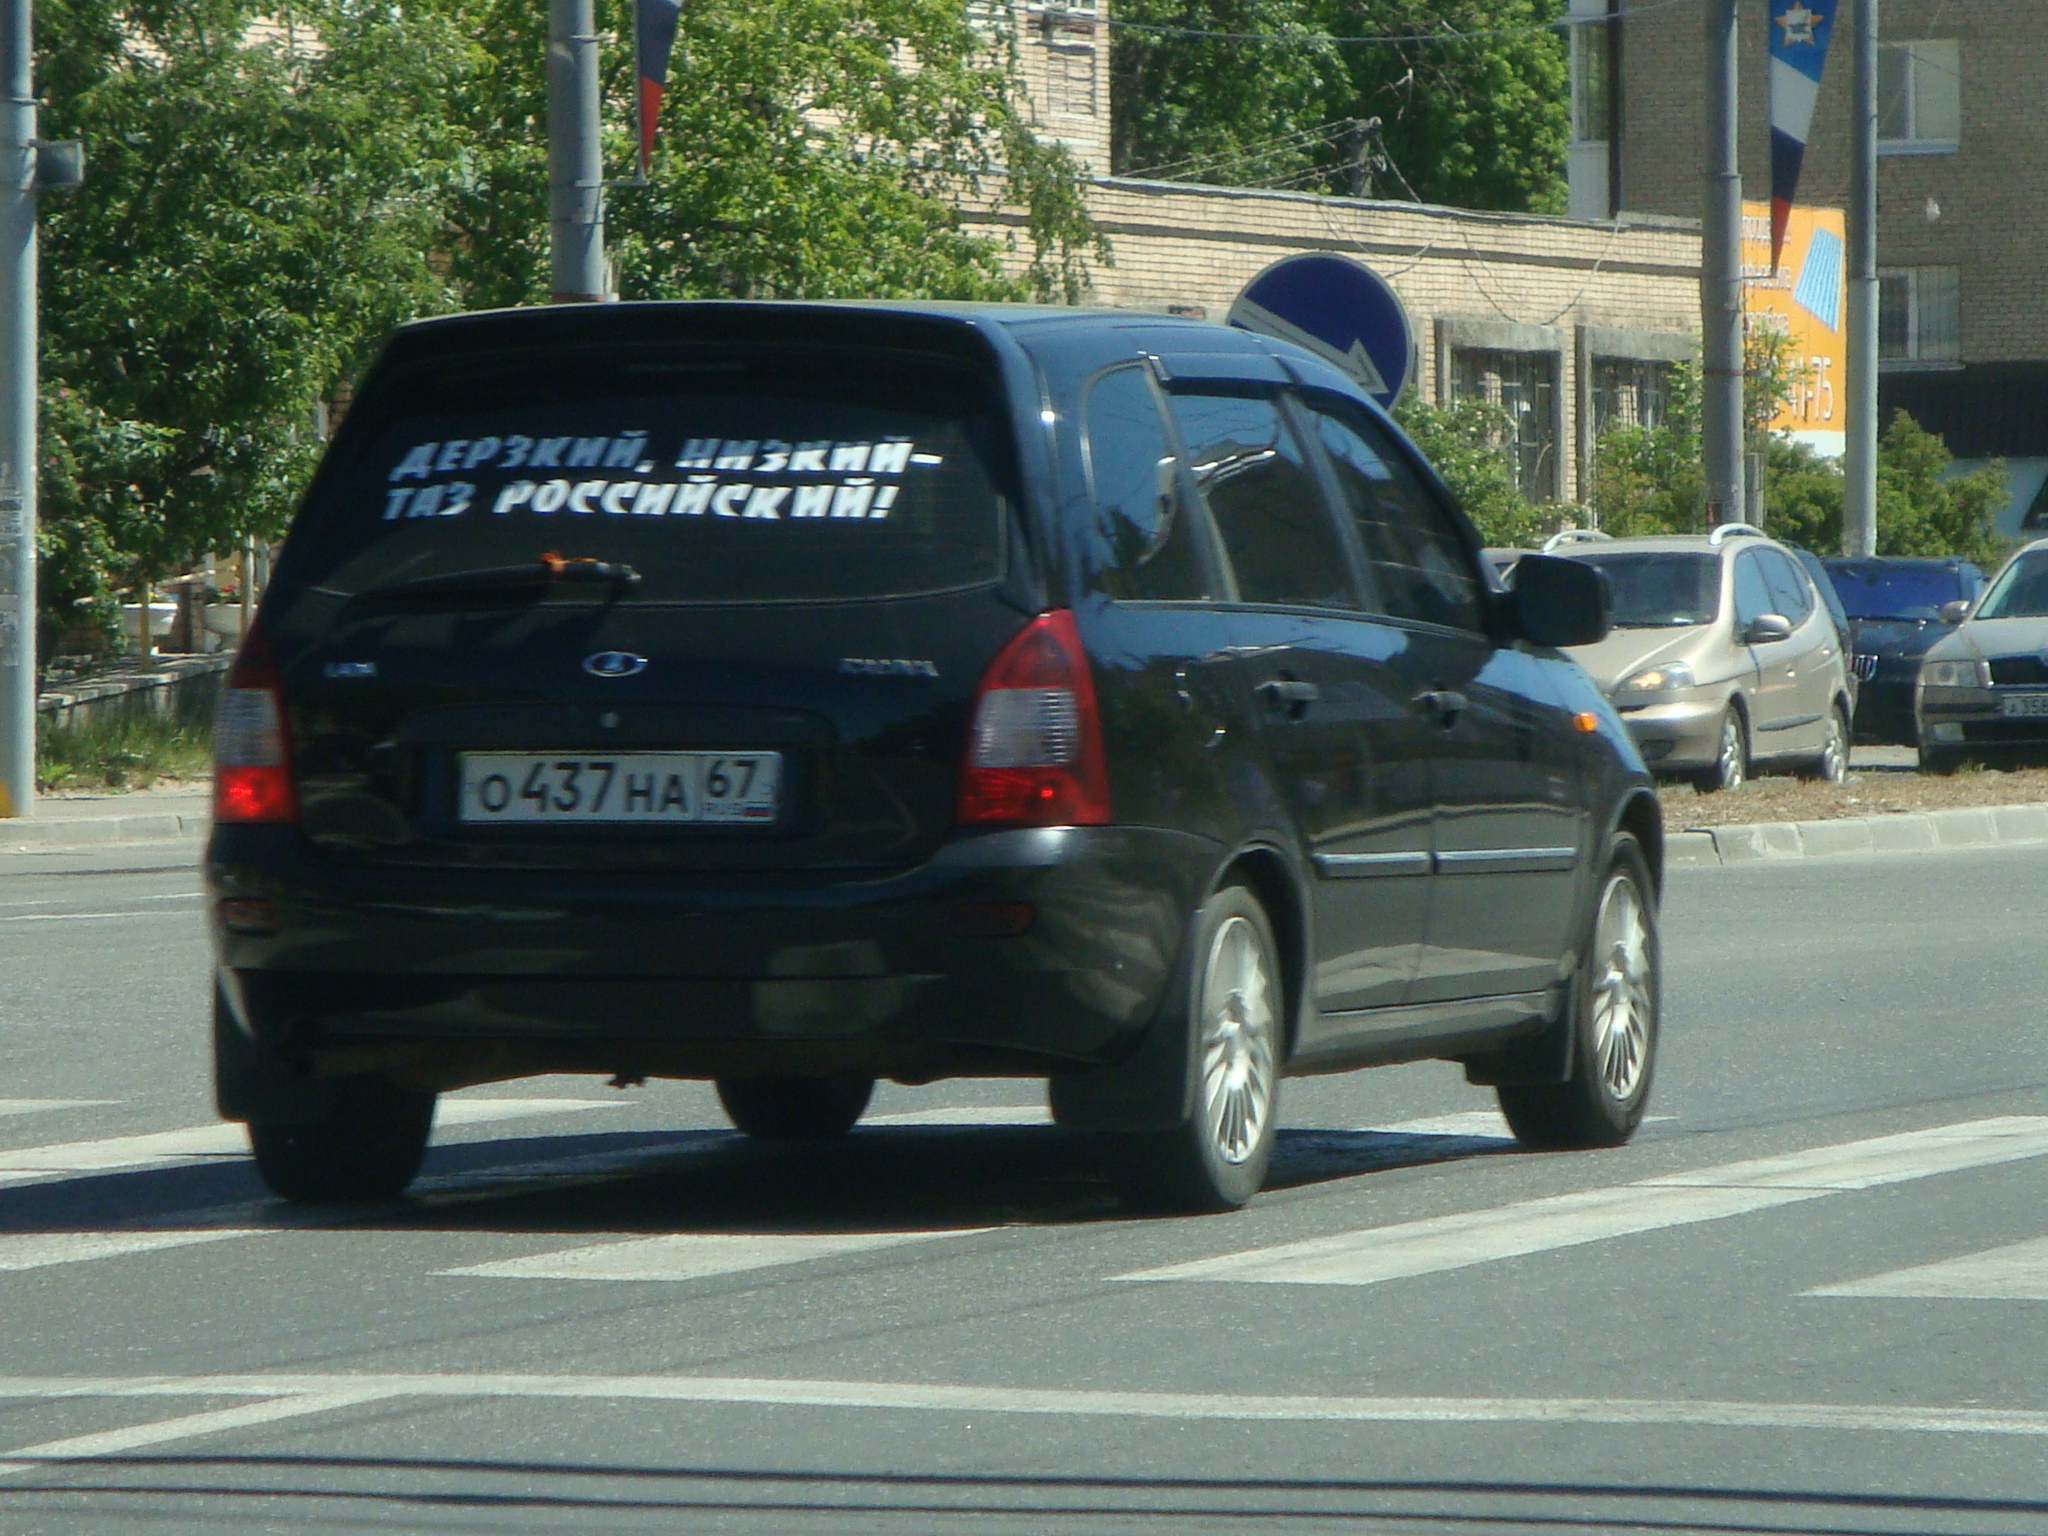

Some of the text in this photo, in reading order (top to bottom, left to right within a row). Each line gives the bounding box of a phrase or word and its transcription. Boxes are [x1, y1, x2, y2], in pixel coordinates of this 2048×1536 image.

[388, 430, 655, 481] ДЕРЗКИЙ,
[383, 474, 900, 520] ТАЗ РОССИЙСКИЙ!
[707, 760, 757, 799] 67
